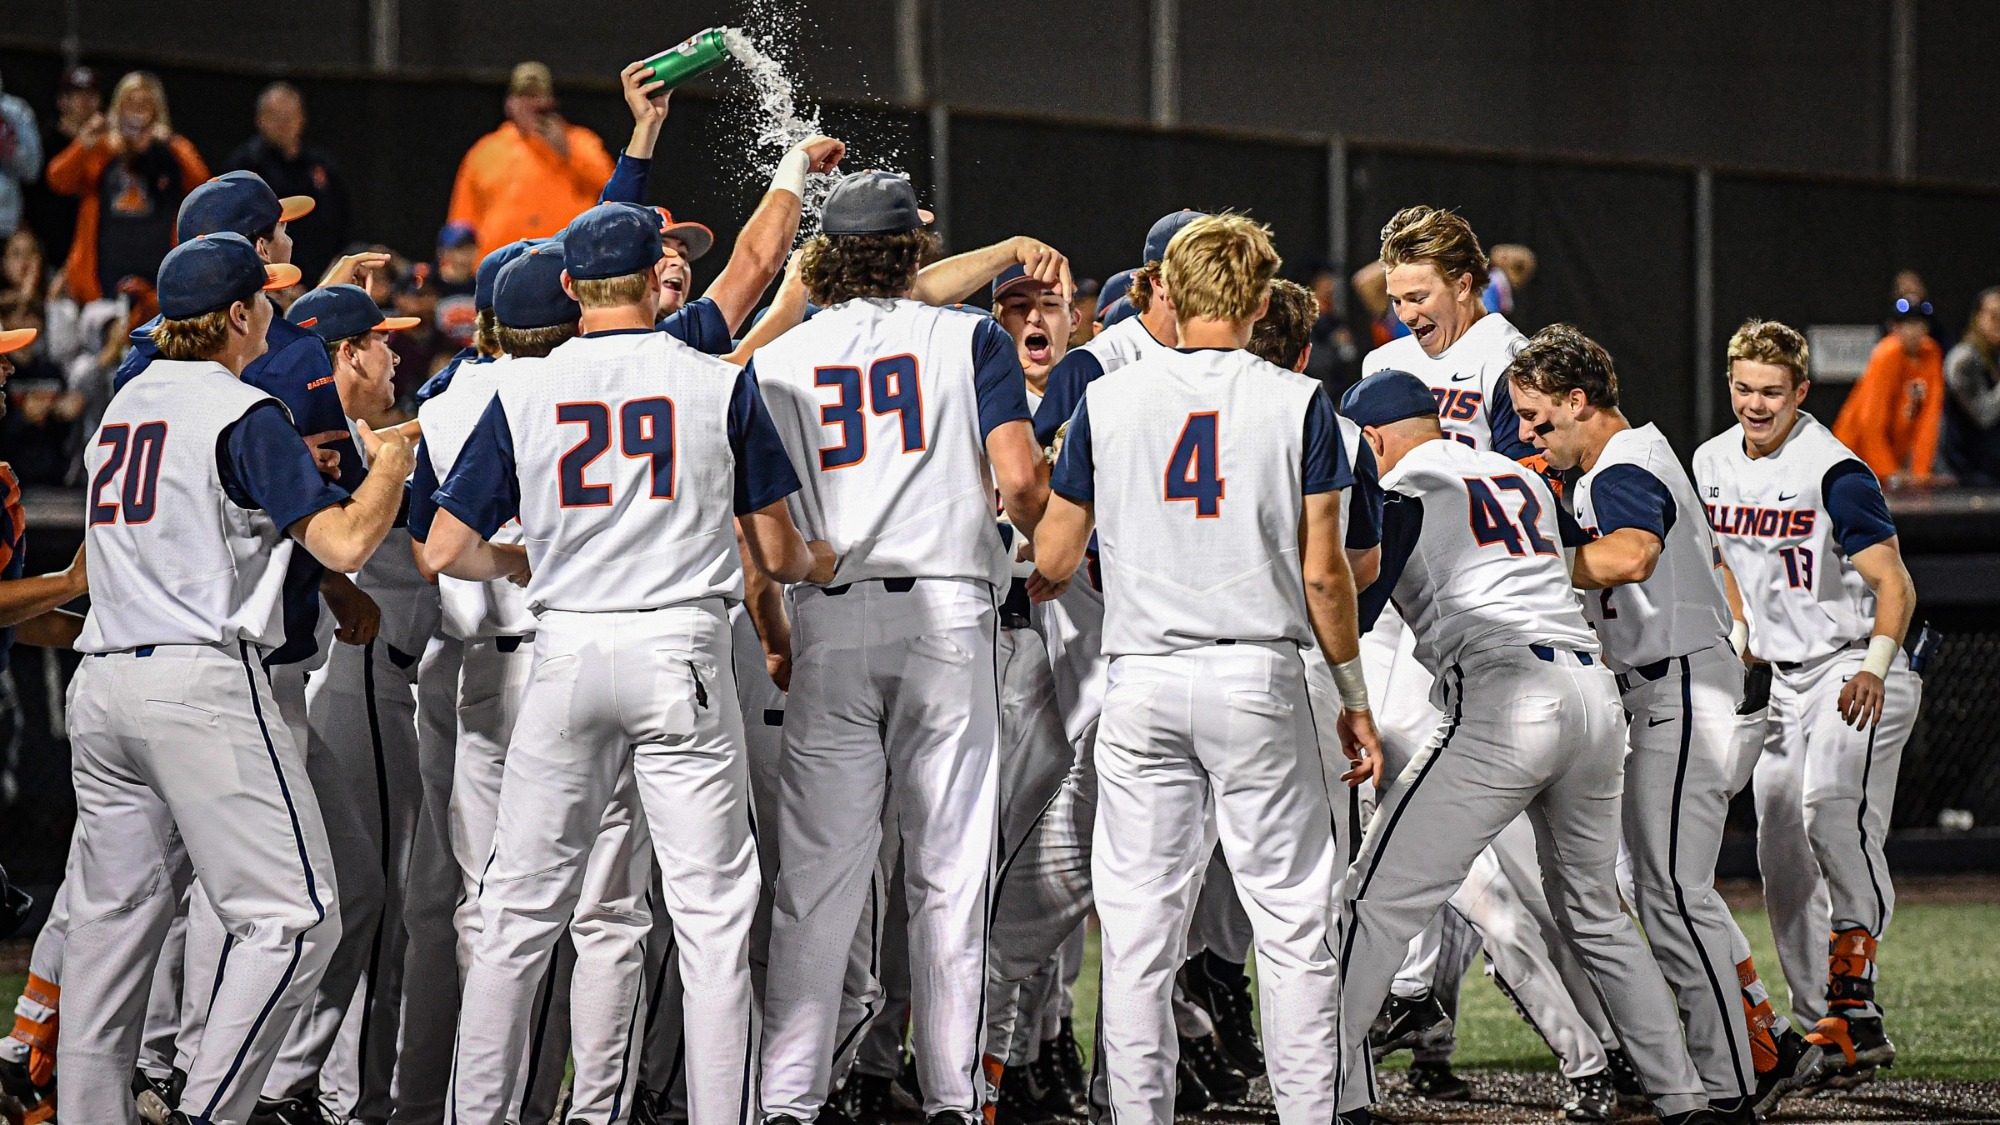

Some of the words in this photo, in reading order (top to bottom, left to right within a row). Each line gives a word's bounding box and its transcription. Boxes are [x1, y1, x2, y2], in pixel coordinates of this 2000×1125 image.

[556, 396, 676, 508] 29
[814, 352, 926, 471] 39
[1164, 411, 1225, 518] 4
[89, 420, 168, 529] 20
[1463, 474, 1560, 558] 42
[1706, 504, 1816, 538] LLINOIS
[1778, 546, 1813, 591] 13
